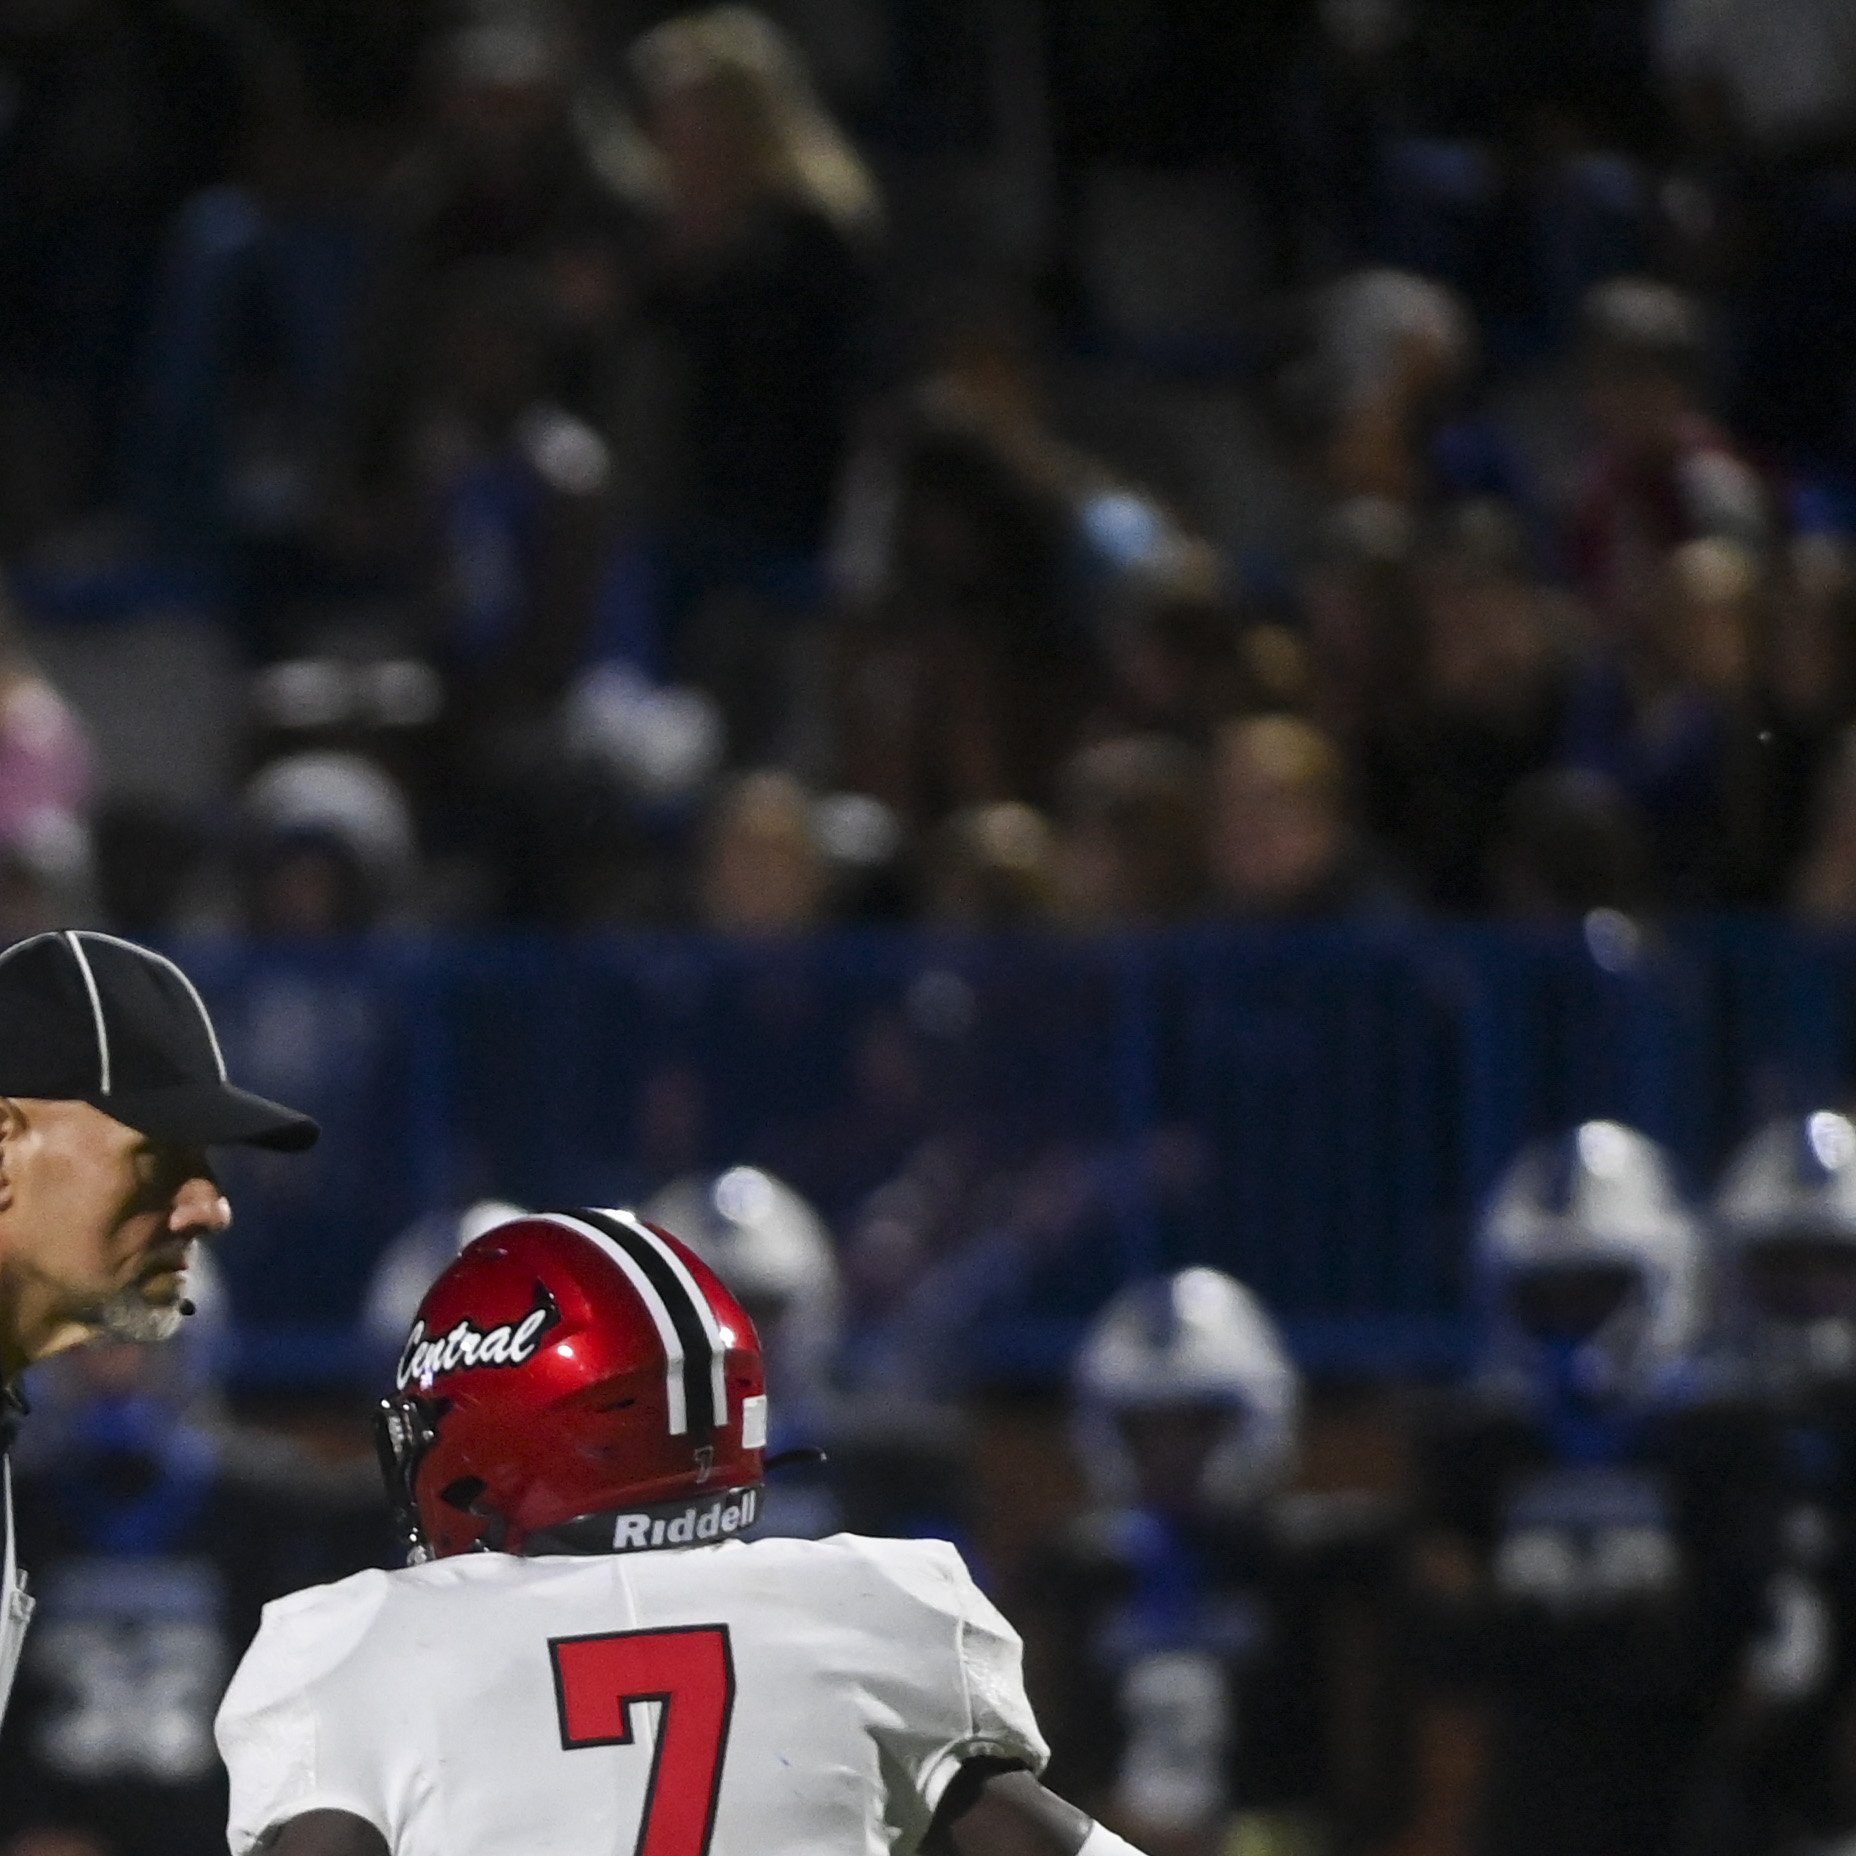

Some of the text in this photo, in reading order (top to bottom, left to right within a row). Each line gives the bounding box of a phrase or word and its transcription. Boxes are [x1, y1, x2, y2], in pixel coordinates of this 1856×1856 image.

[396, 1308, 546, 1391] Central
[693, 1444, 715, 1484] 7
[612, 1488, 757, 1550] Riddell
